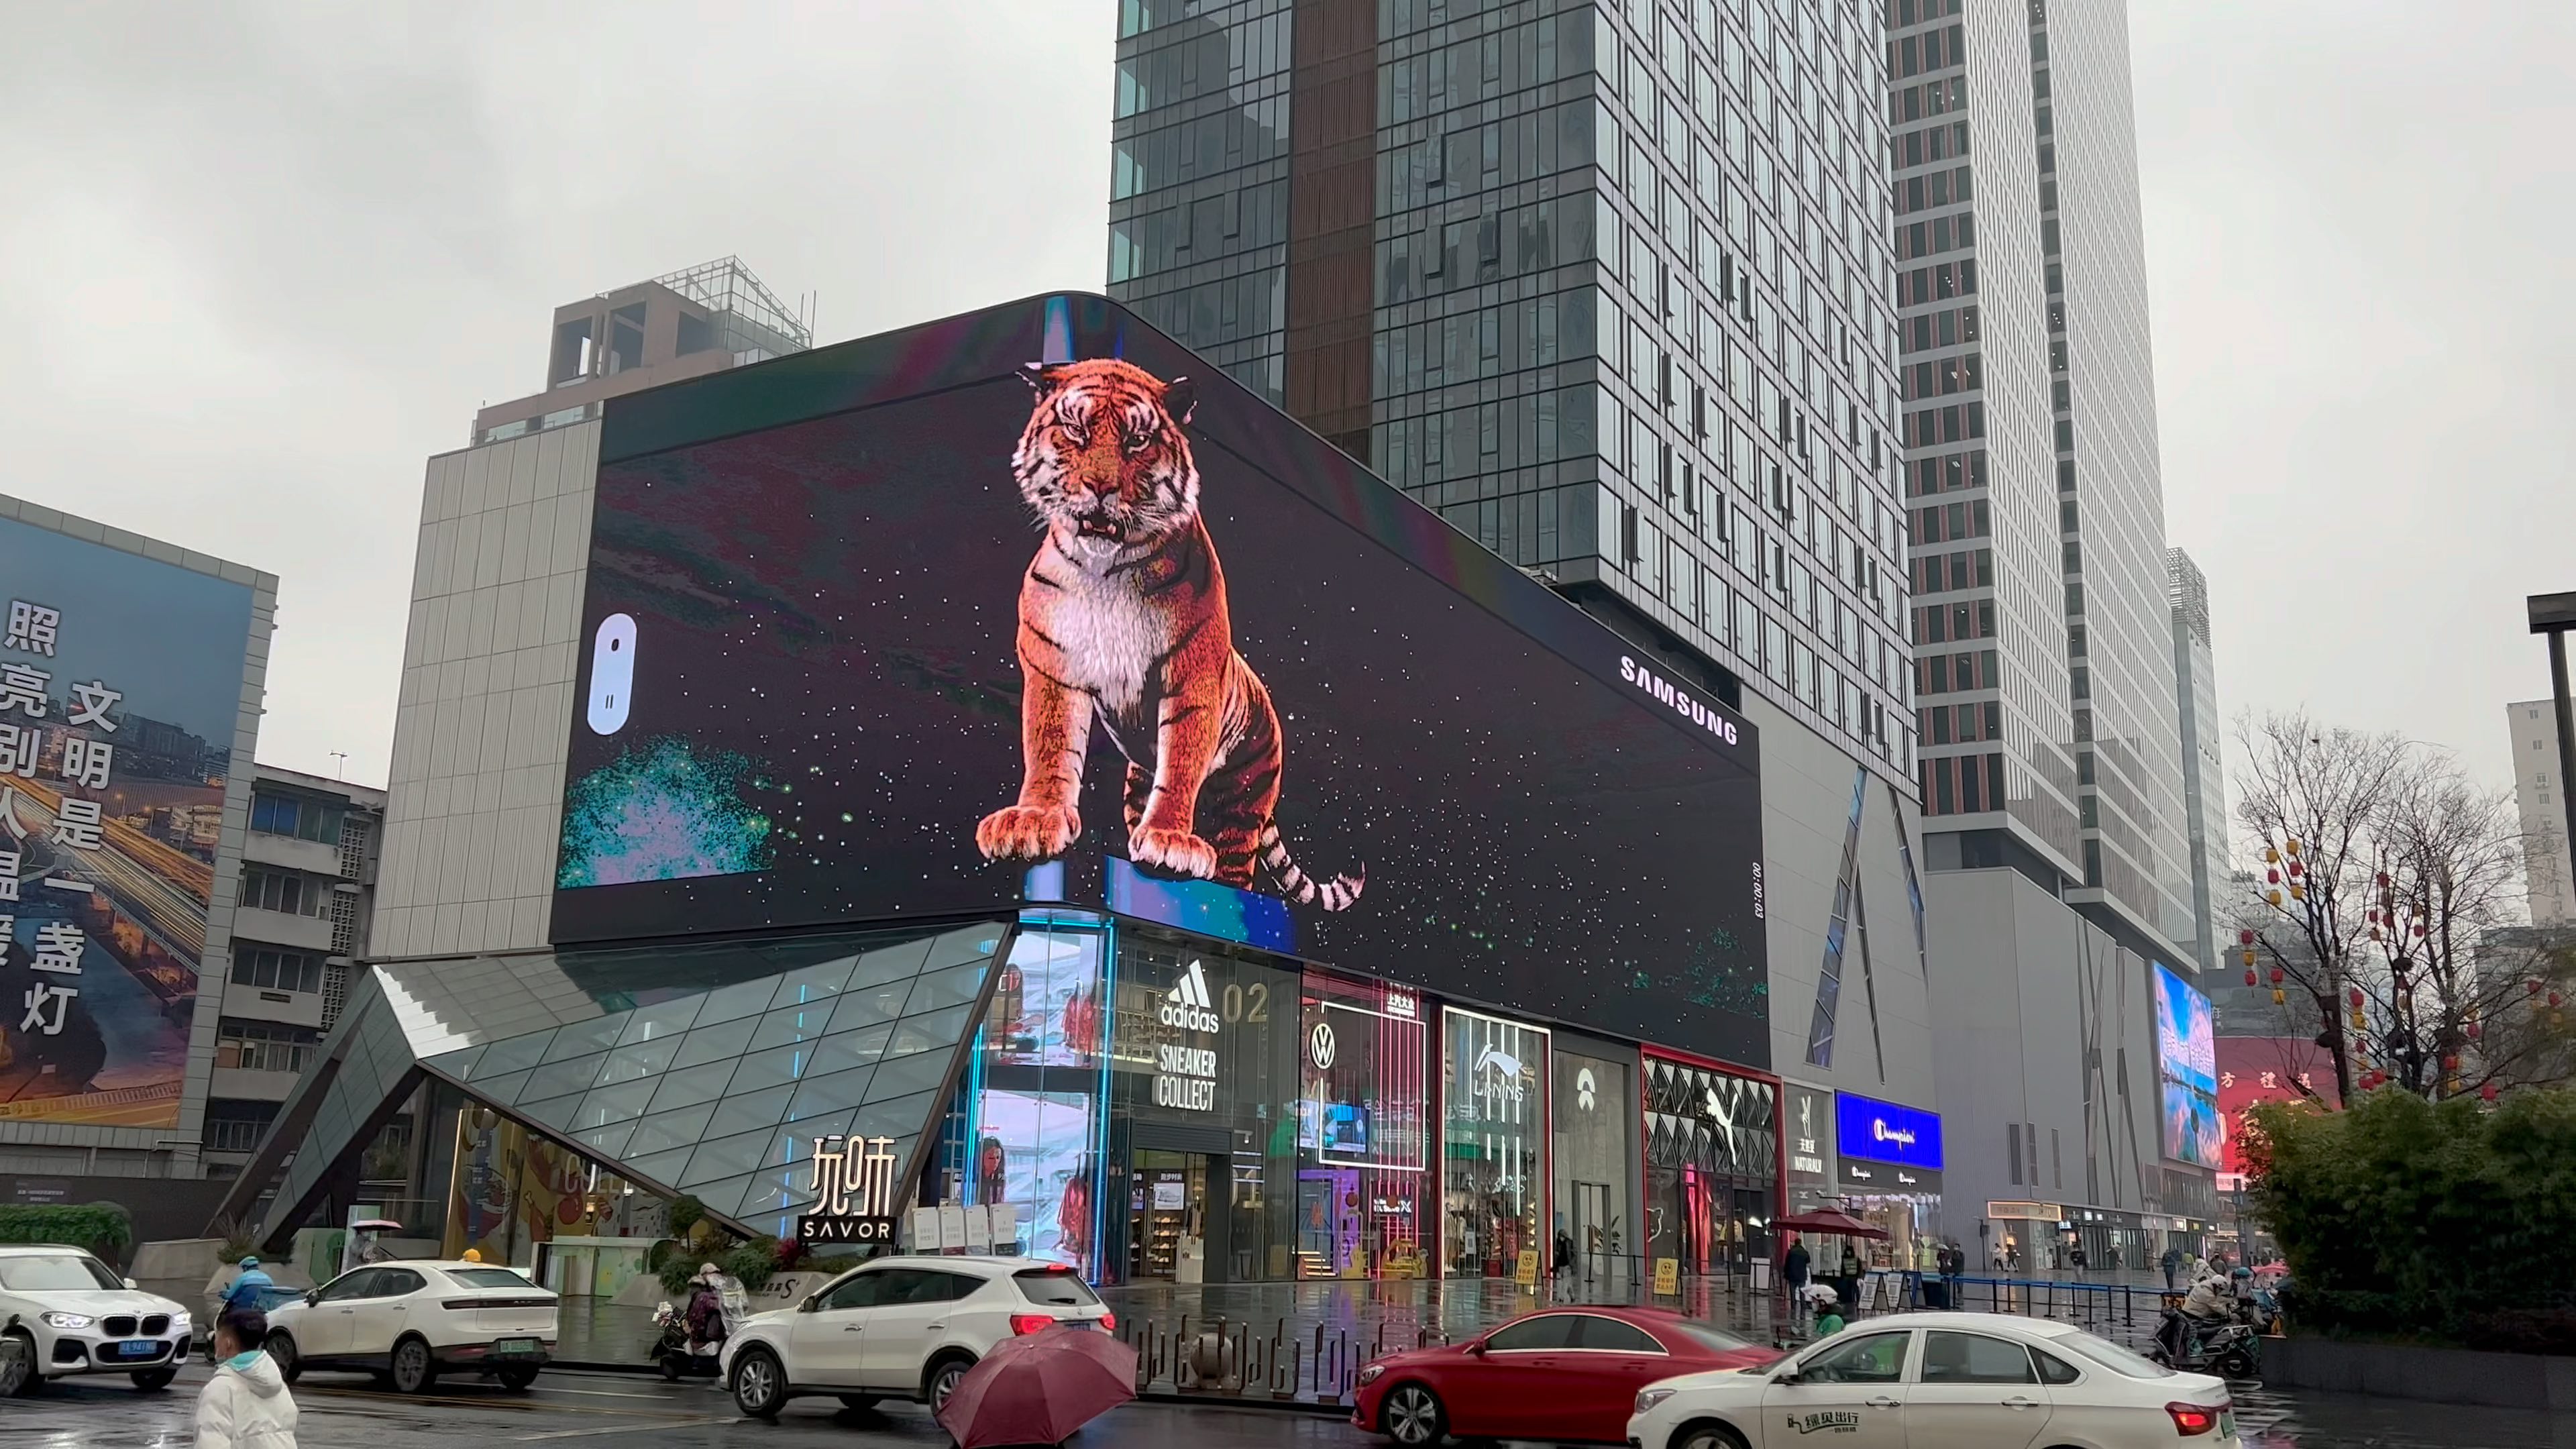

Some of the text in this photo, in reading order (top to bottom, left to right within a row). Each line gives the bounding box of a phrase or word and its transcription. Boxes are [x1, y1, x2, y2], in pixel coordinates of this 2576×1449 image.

[1621, 655, 1738, 746] SAMSUNG
[20, 681, 122, 1036] 文明是一盏灯
[1161, 1002, 1219, 1034] adidas
[1160, 1044, 1217, 1078] SNEAKER
[1159, 1075, 1216, 1112] COLLECT
[1874, 1118, 1916, 1150] Champion
[1794, 1156, 1822, 1173] NATURALY
[804, 1222, 890, 1239] SAVOR
